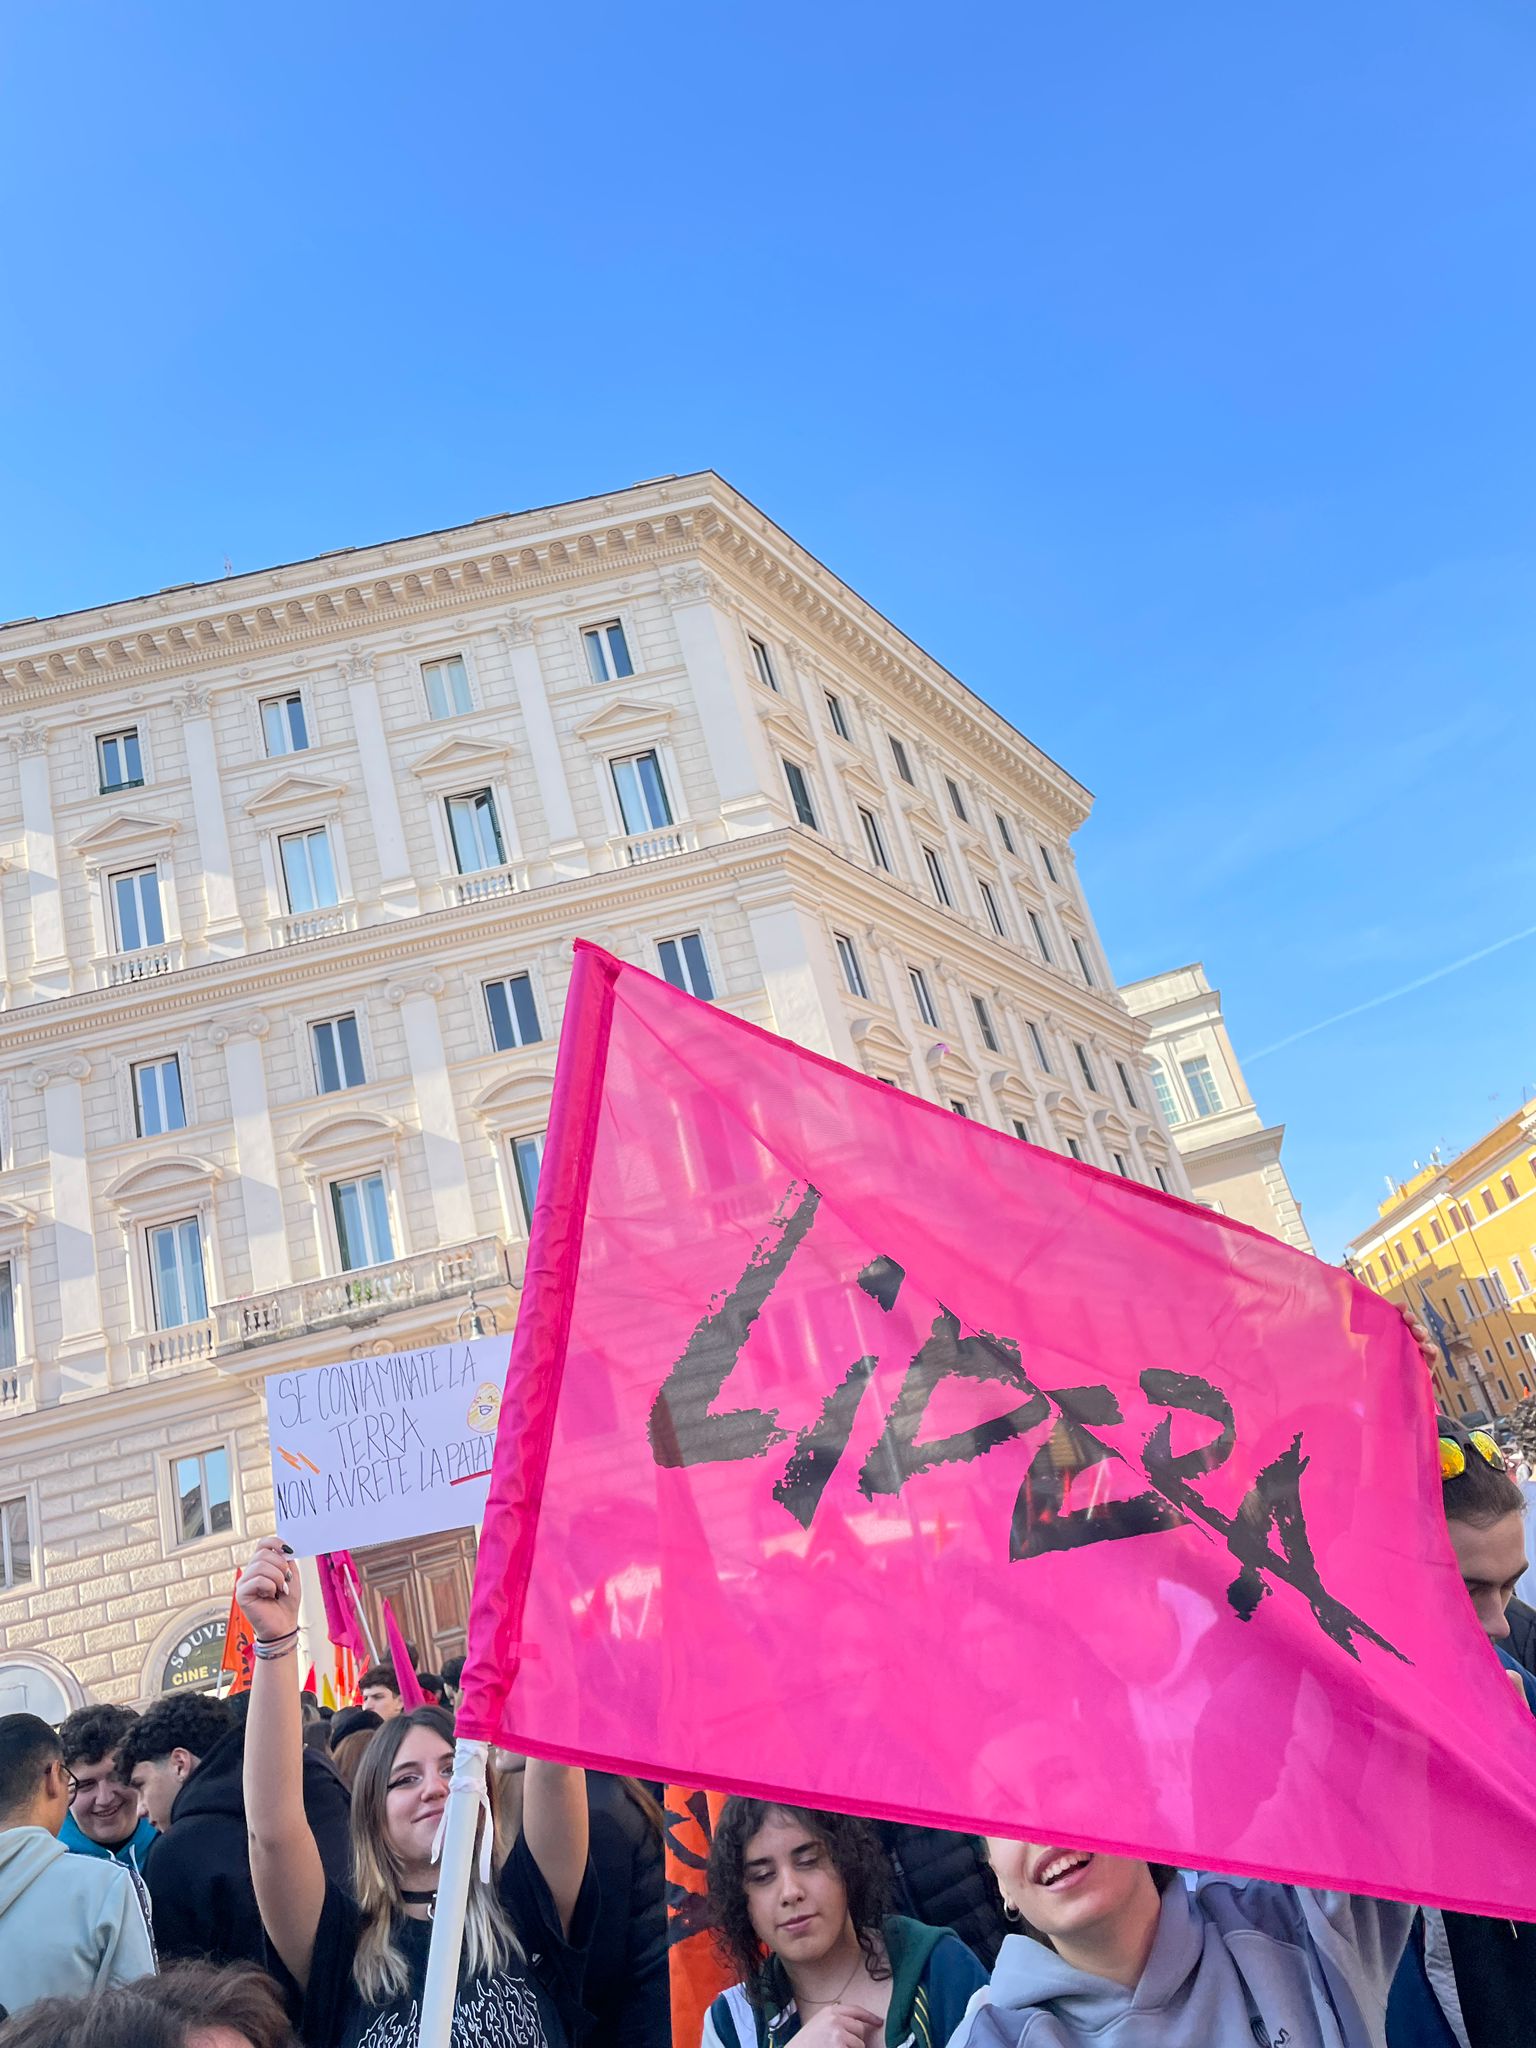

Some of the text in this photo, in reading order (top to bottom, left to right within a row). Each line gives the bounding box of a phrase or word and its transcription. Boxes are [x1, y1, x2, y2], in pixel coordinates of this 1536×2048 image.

[278, 1346, 477, 1428] SE CONTAMINATE LA
[328, 1407, 425, 1469] TERRA
[277, 1433, 495, 1521] NON AVRETE LA PATAT
[170, 1622, 226, 1669] SOUVE
[172, 1665, 209, 1686] CINE
